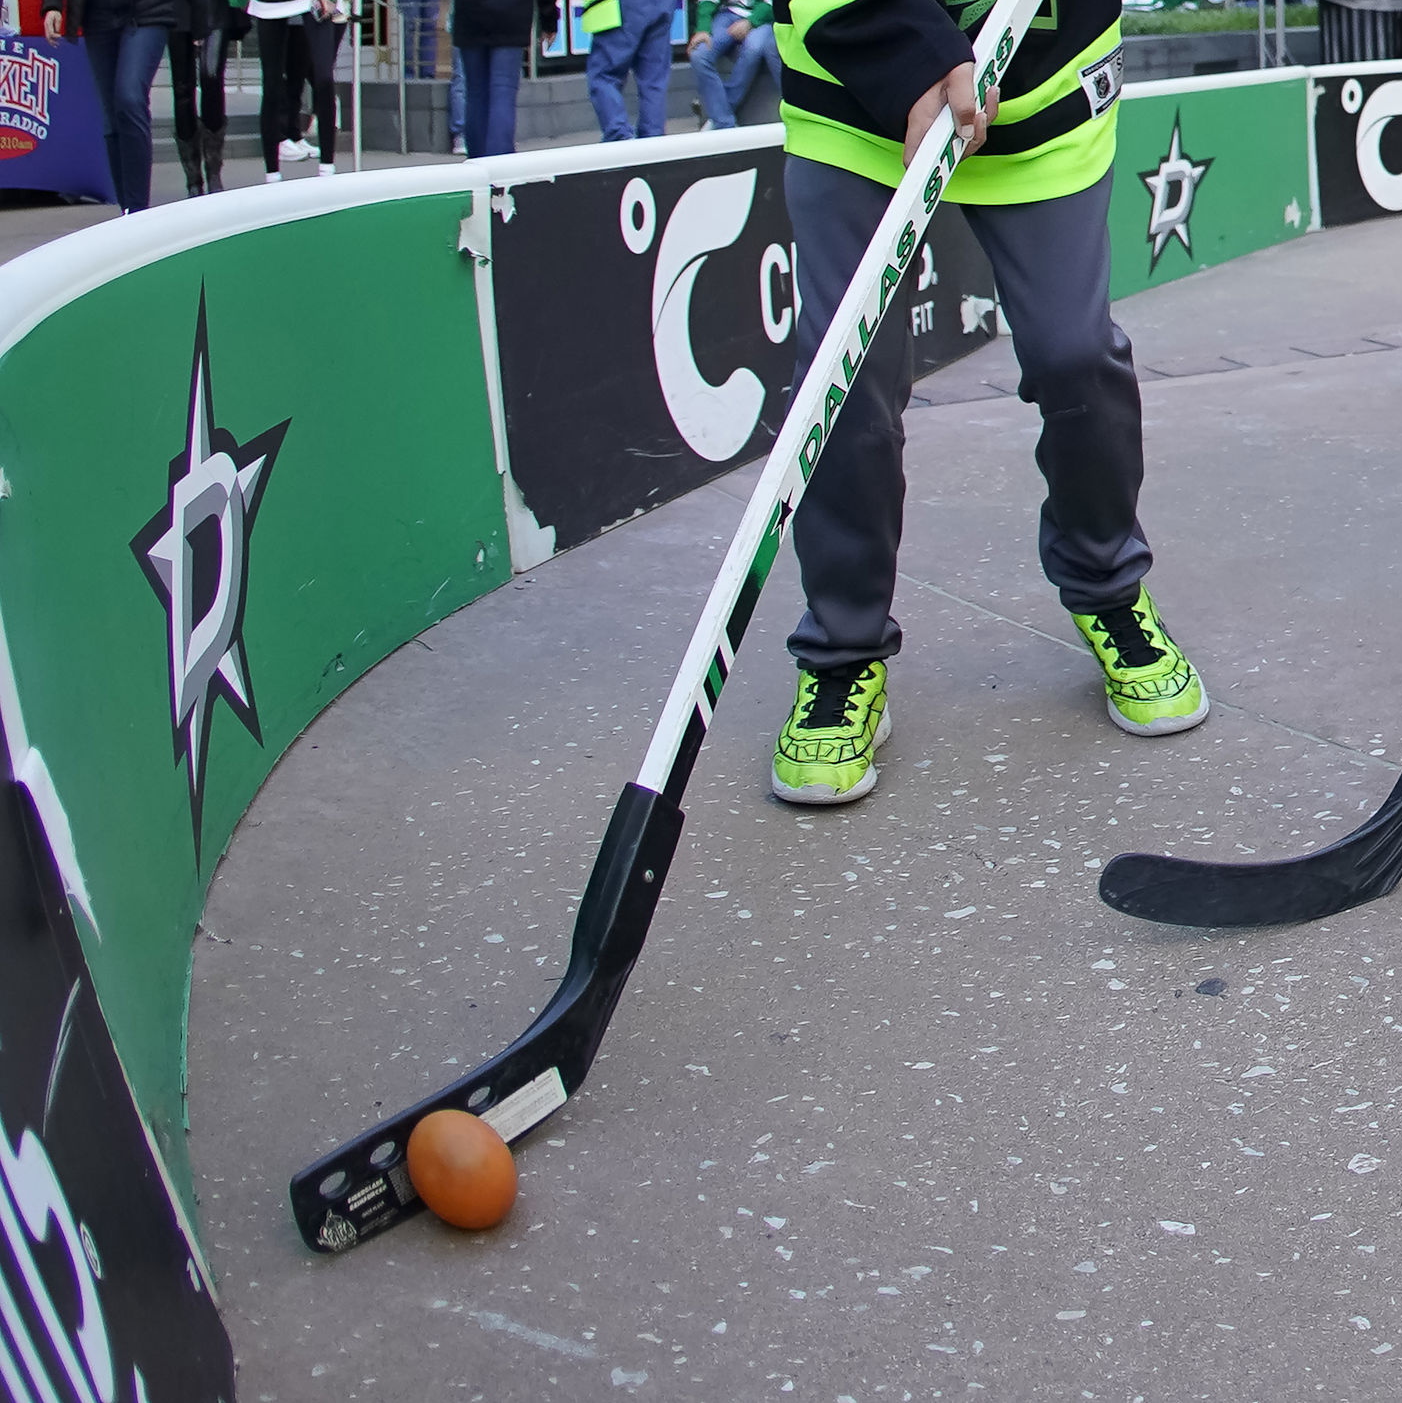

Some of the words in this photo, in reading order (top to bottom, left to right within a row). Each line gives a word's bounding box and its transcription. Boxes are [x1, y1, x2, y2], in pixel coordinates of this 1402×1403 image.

[0, 46, 60, 127] KET
[799, 219, 918, 485] DALLAS
[923, 26, 1014, 215] STRS
[911, 300, 935, 337] FIT
